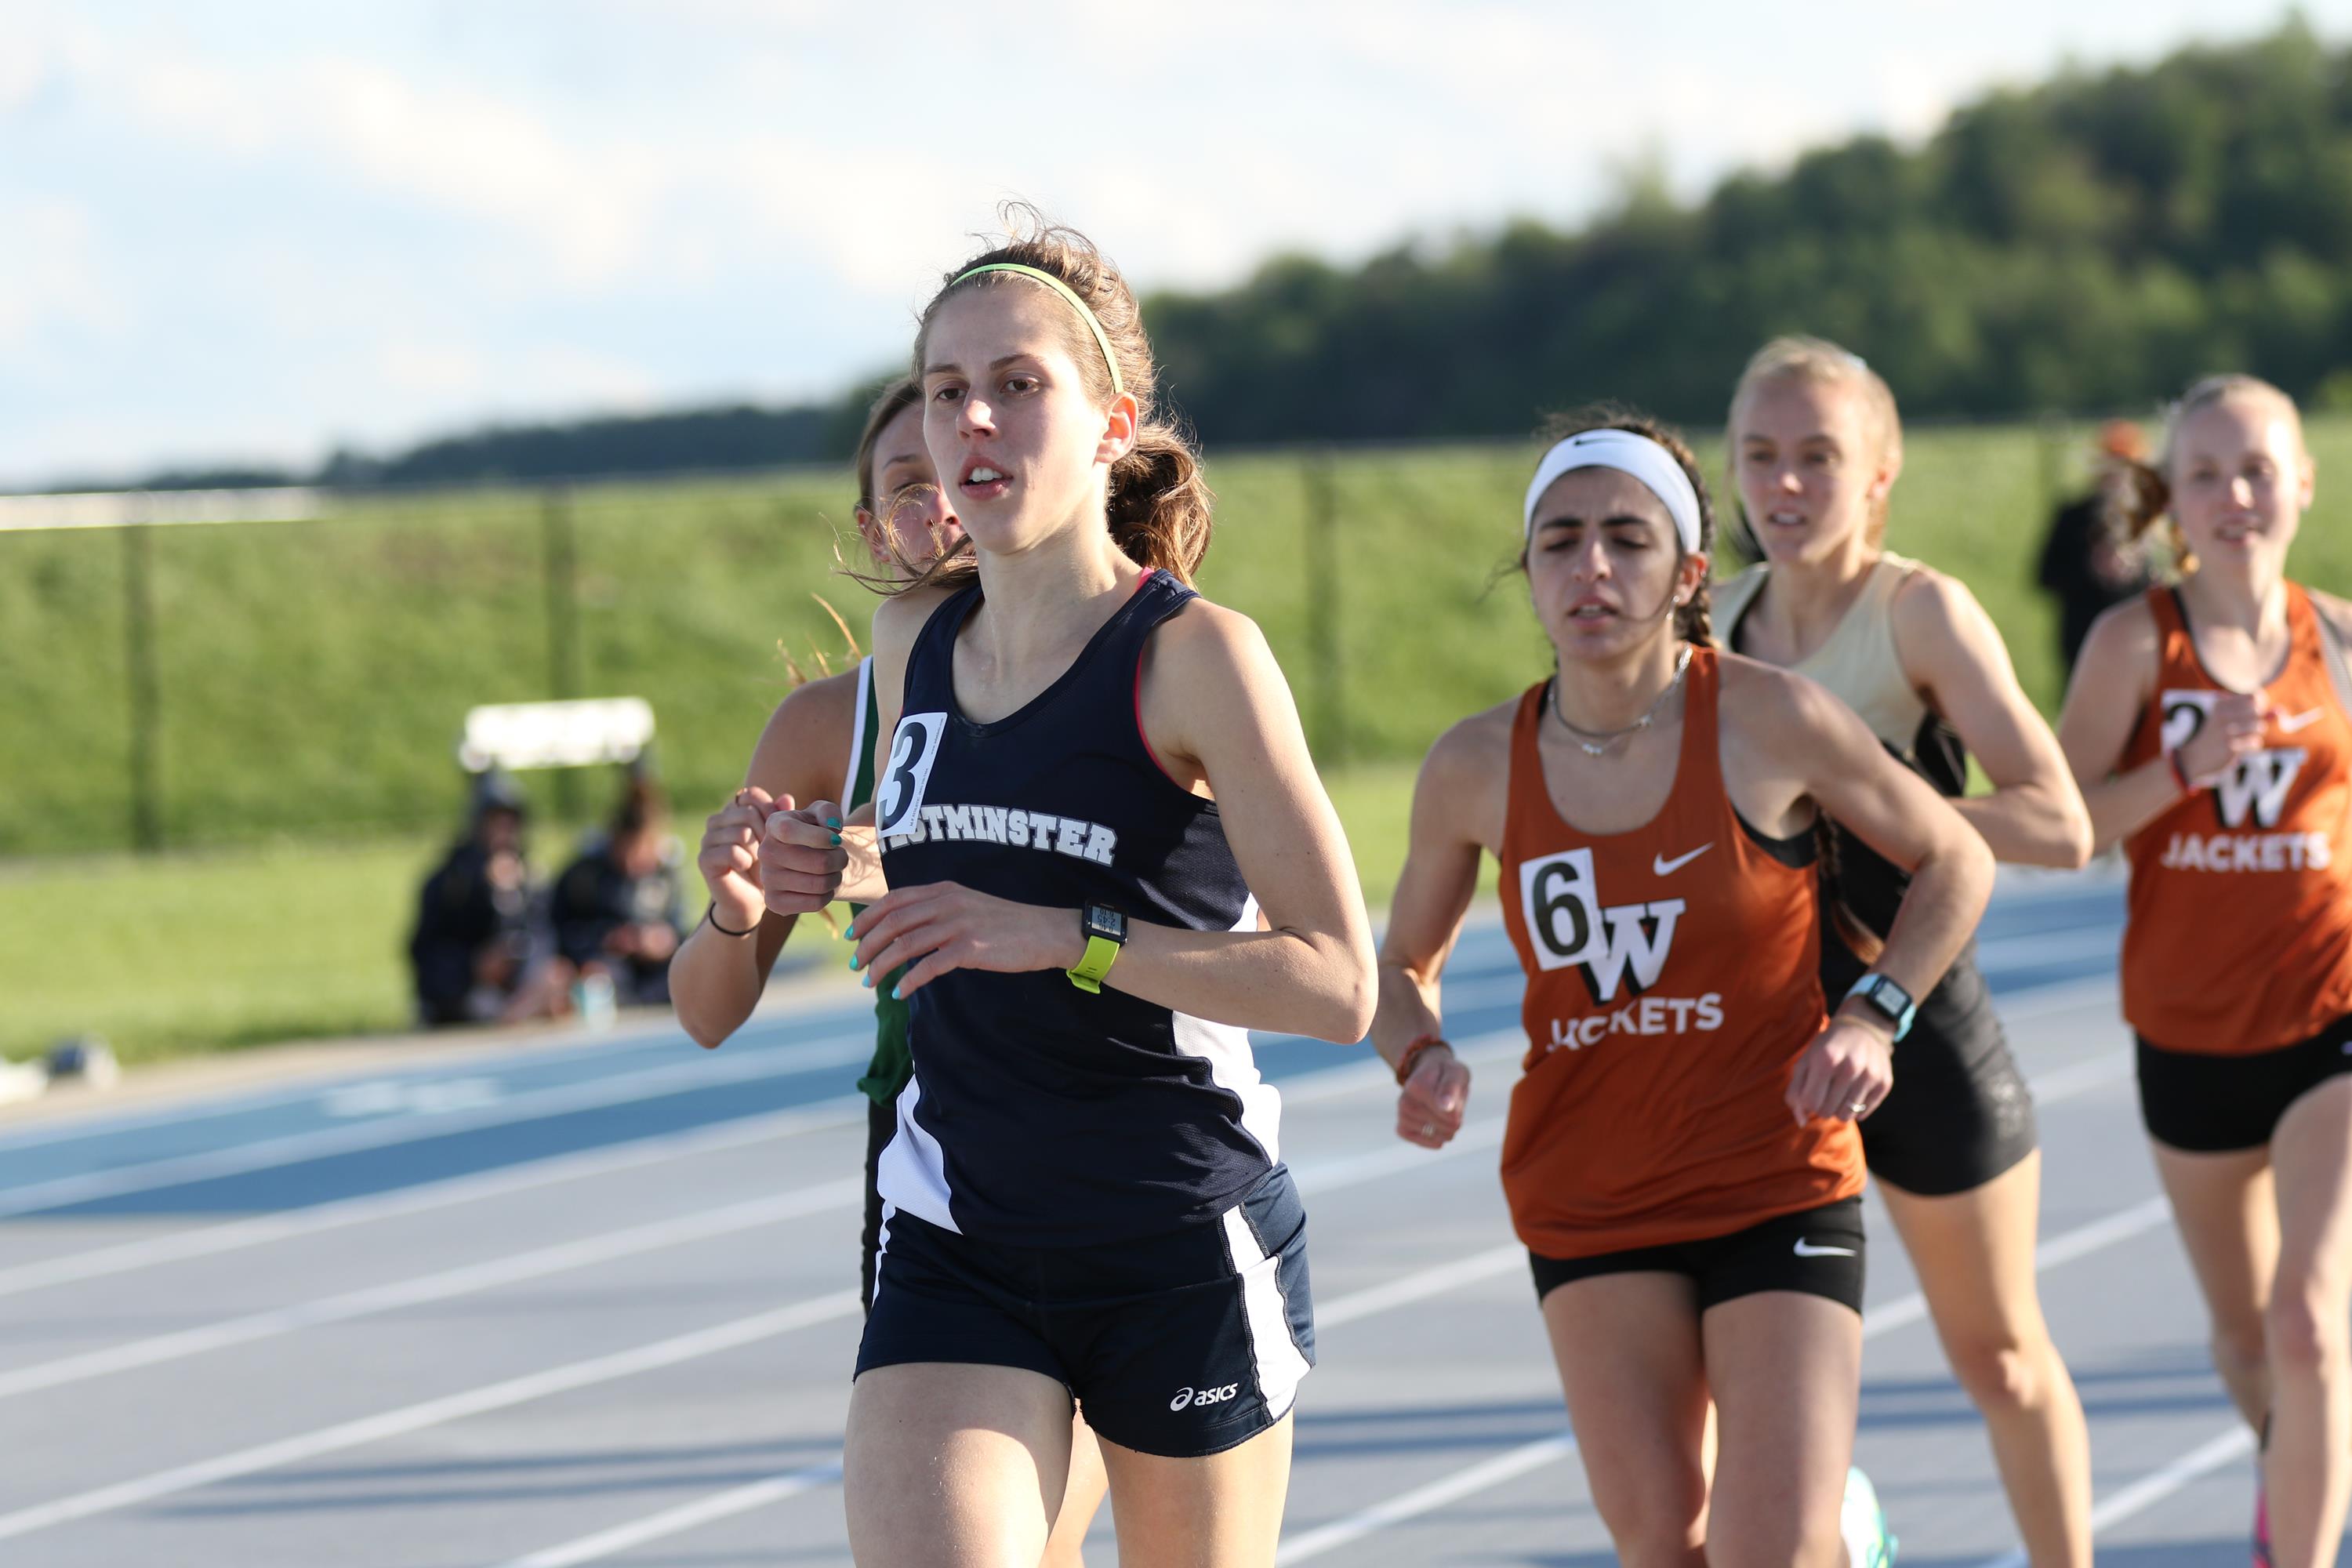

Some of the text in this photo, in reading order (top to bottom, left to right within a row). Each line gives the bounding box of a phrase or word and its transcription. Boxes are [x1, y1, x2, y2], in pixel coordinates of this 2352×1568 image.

[878, 721, 927, 831] 3
[878, 804, 1118, 867] TMINSTER
[2161, 832, 2331, 872] JACKETS
[1098, 914, 1116, 927] 2:45
[1533, 861, 1590, 957] 6
[1578, 897, 1686, 1007] W
[1193, 1383, 1238, 1406] asics
